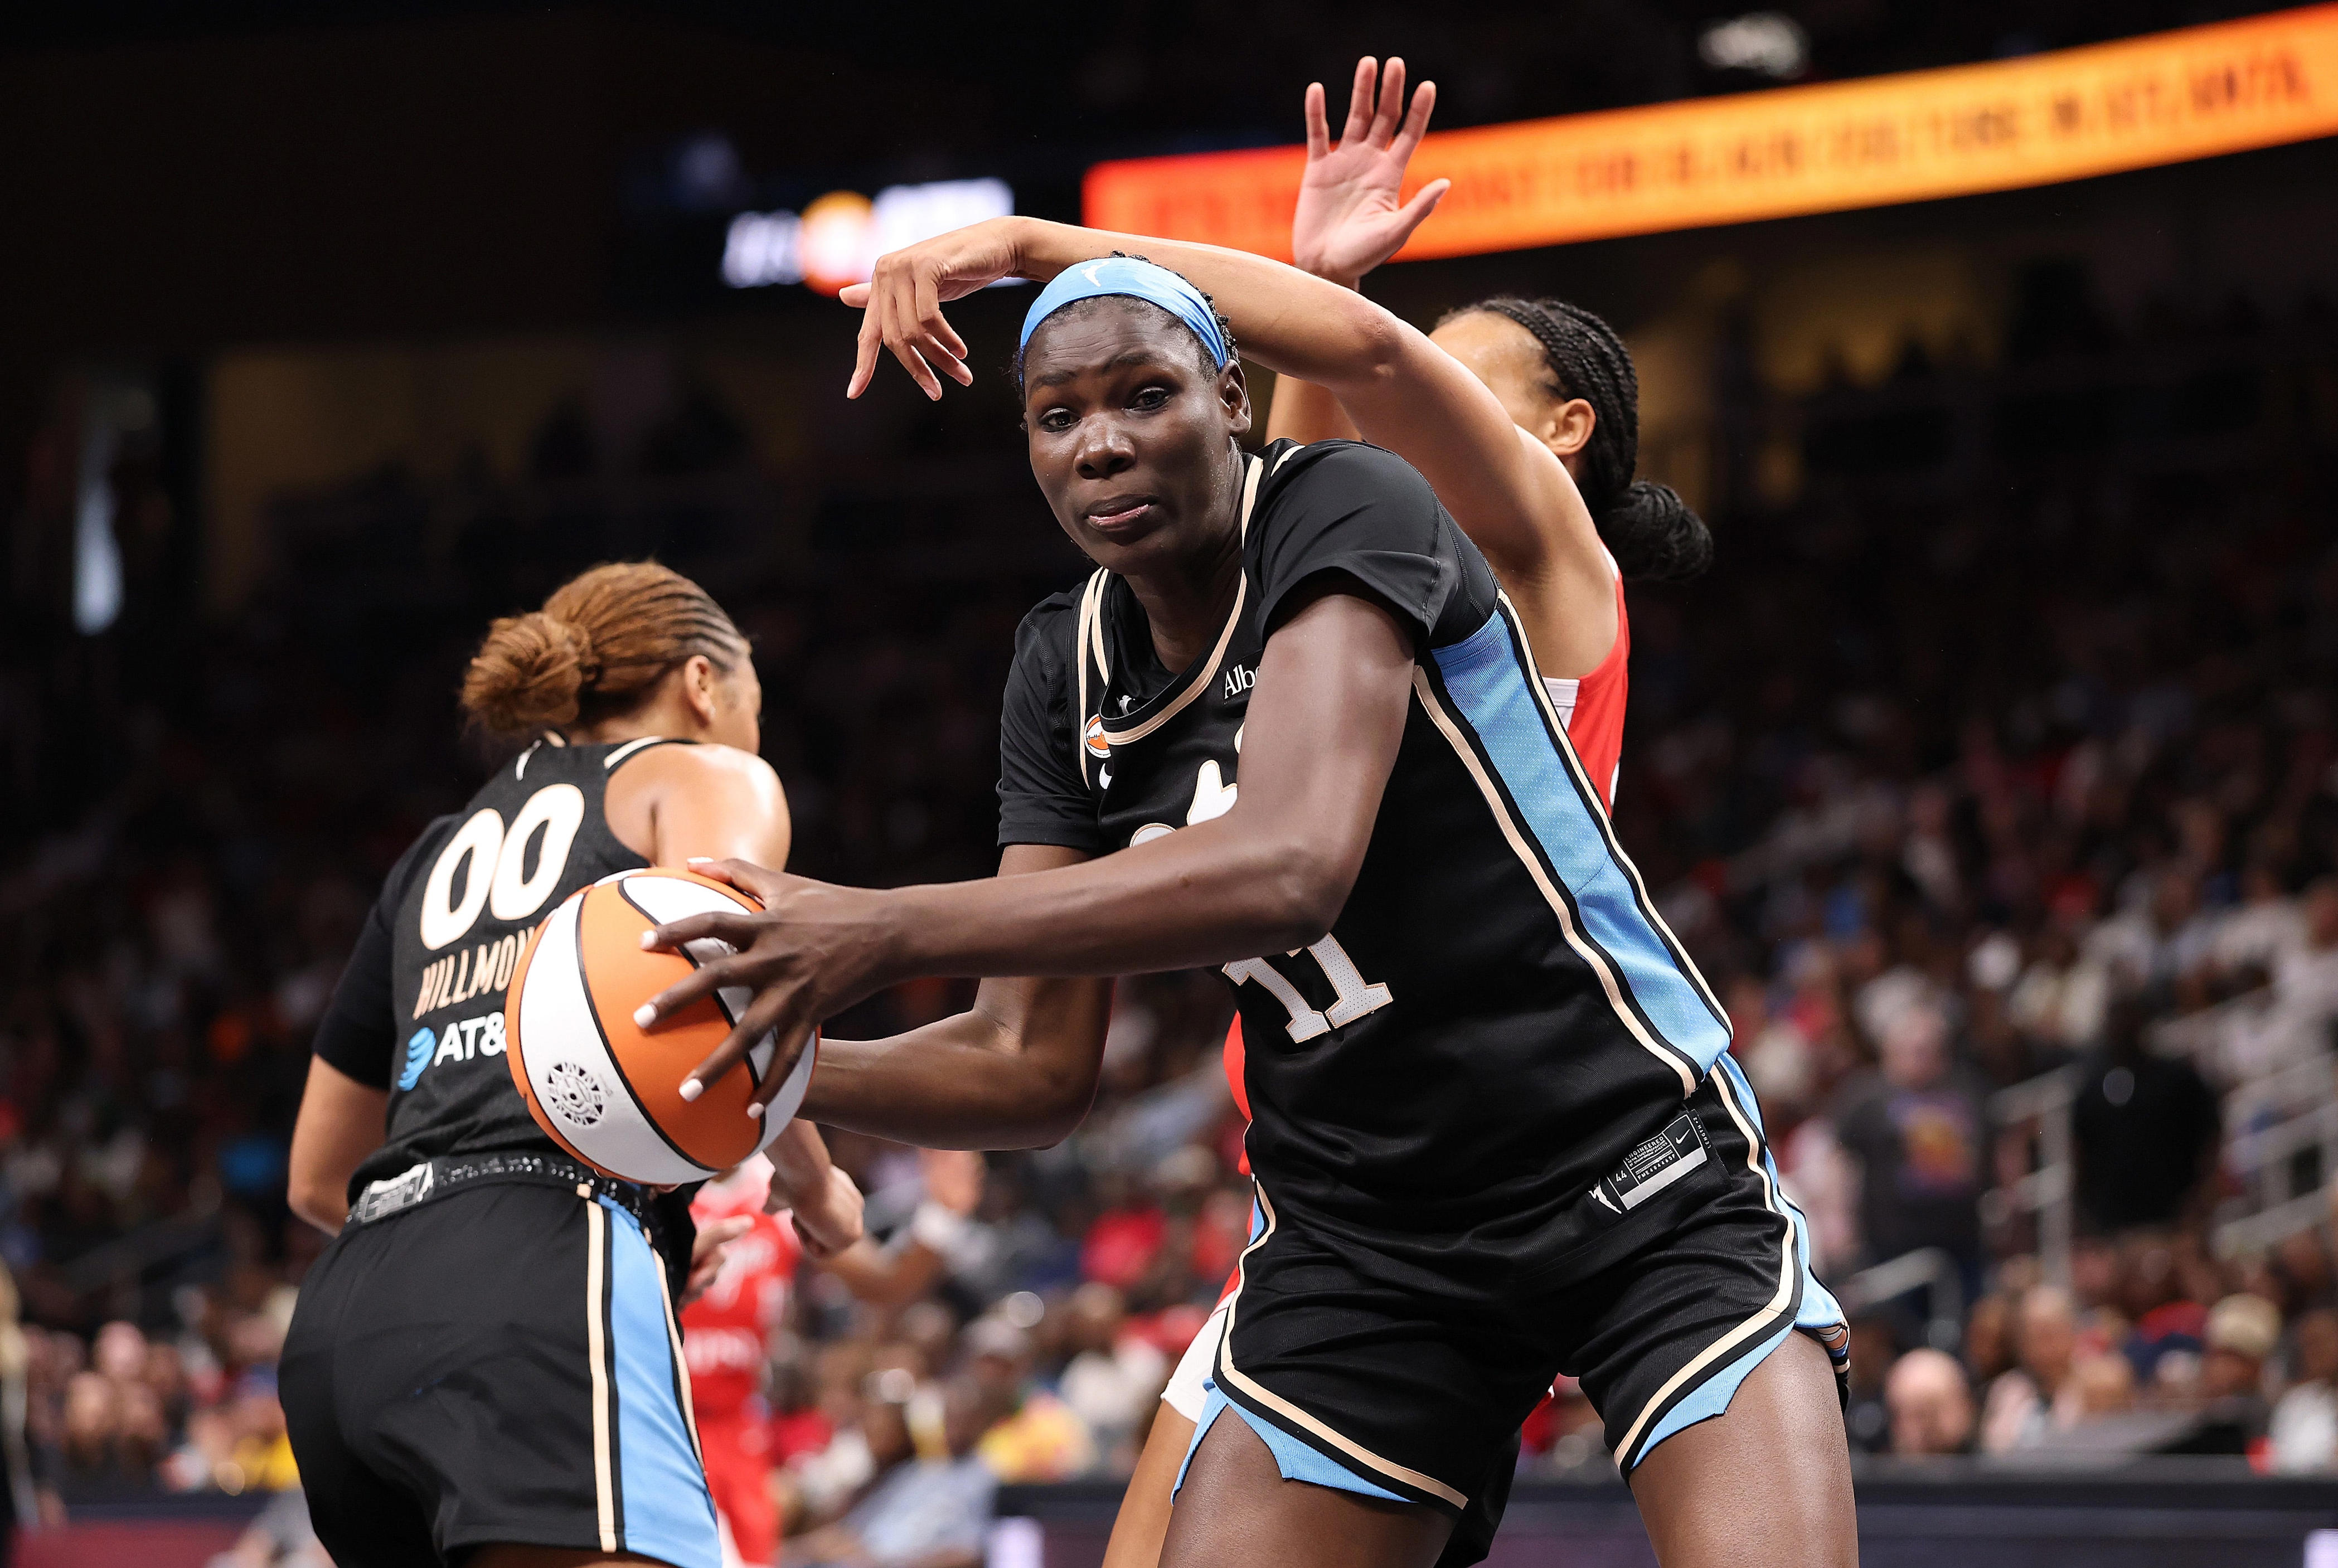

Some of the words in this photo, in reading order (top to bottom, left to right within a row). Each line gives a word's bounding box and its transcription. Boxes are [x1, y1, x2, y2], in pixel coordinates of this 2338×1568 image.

[420, 783, 586, 952] 00
[1624, 1136, 1664, 1161] ENGINEERED
[1616, 1169, 1627, 1182] 44
